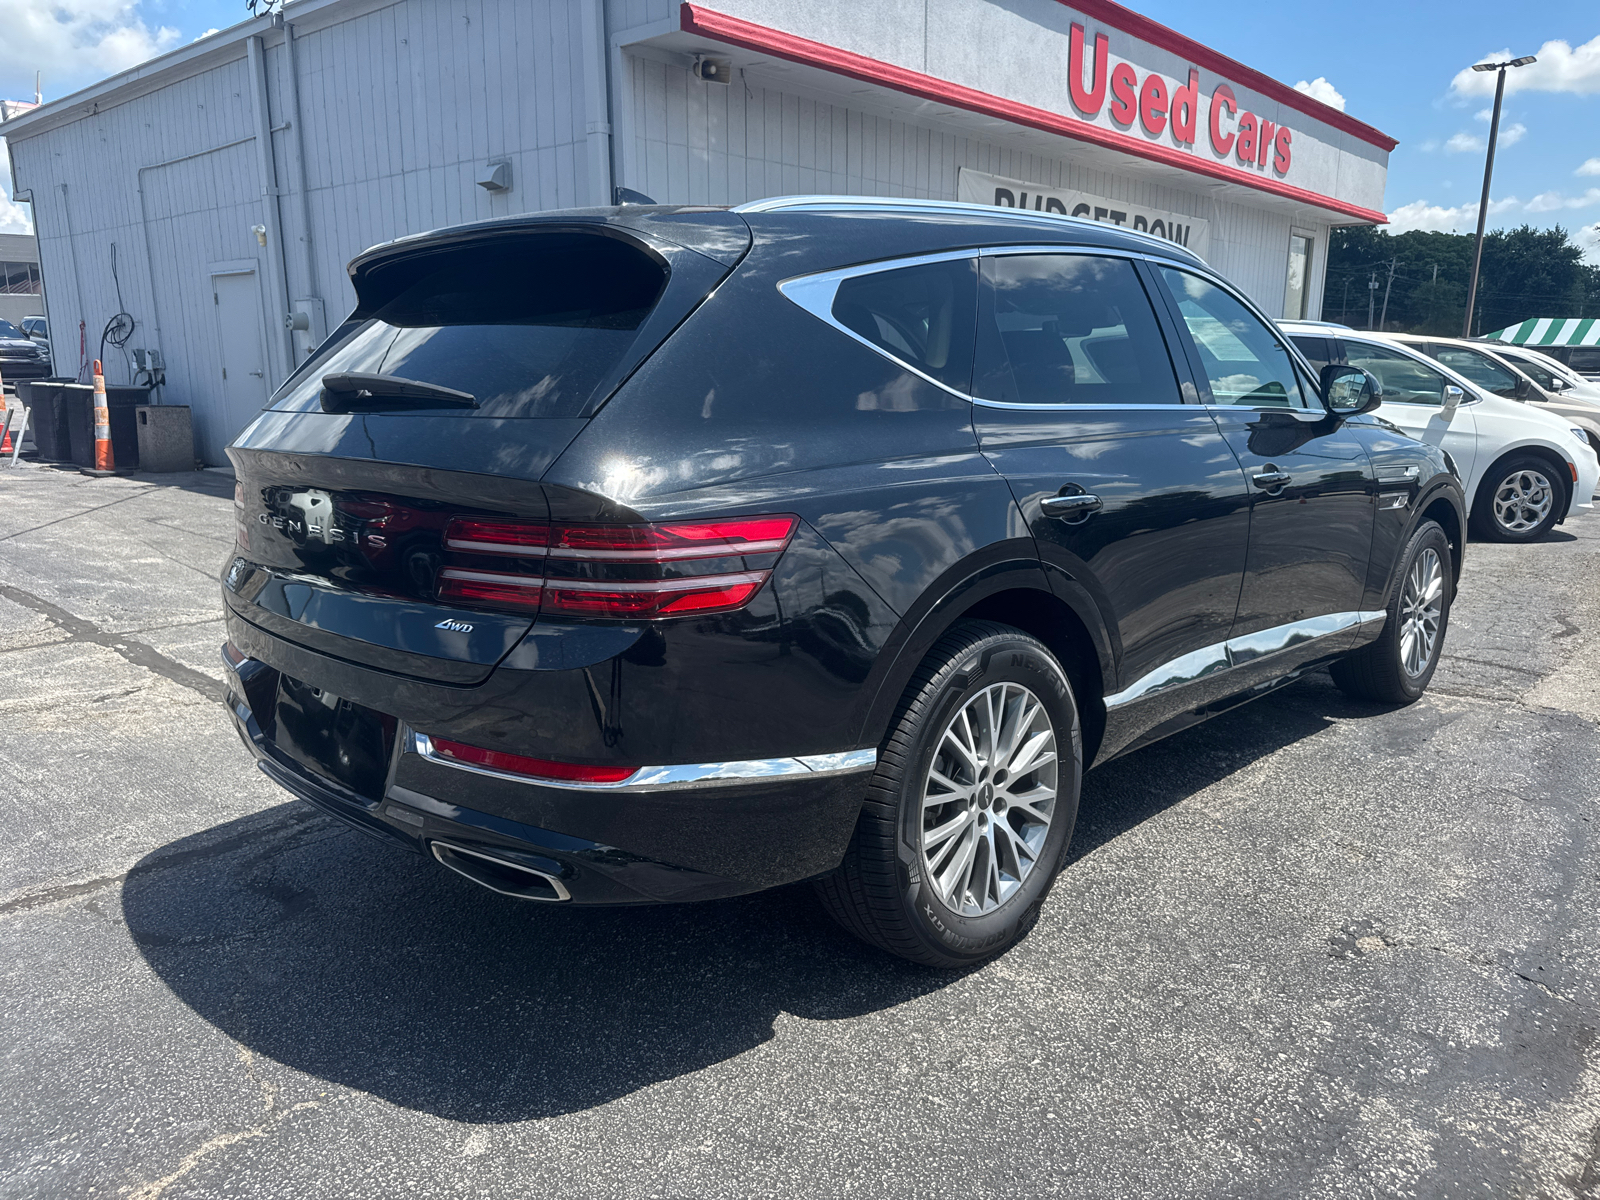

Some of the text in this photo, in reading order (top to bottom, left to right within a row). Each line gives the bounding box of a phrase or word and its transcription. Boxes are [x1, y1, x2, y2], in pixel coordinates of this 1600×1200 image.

[1069, 22, 1292, 174] Used Cars
[258, 513, 387, 548] GENESIS
[434, 618, 474, 633] 4WD
[923, 903, 945, 932] GTX
